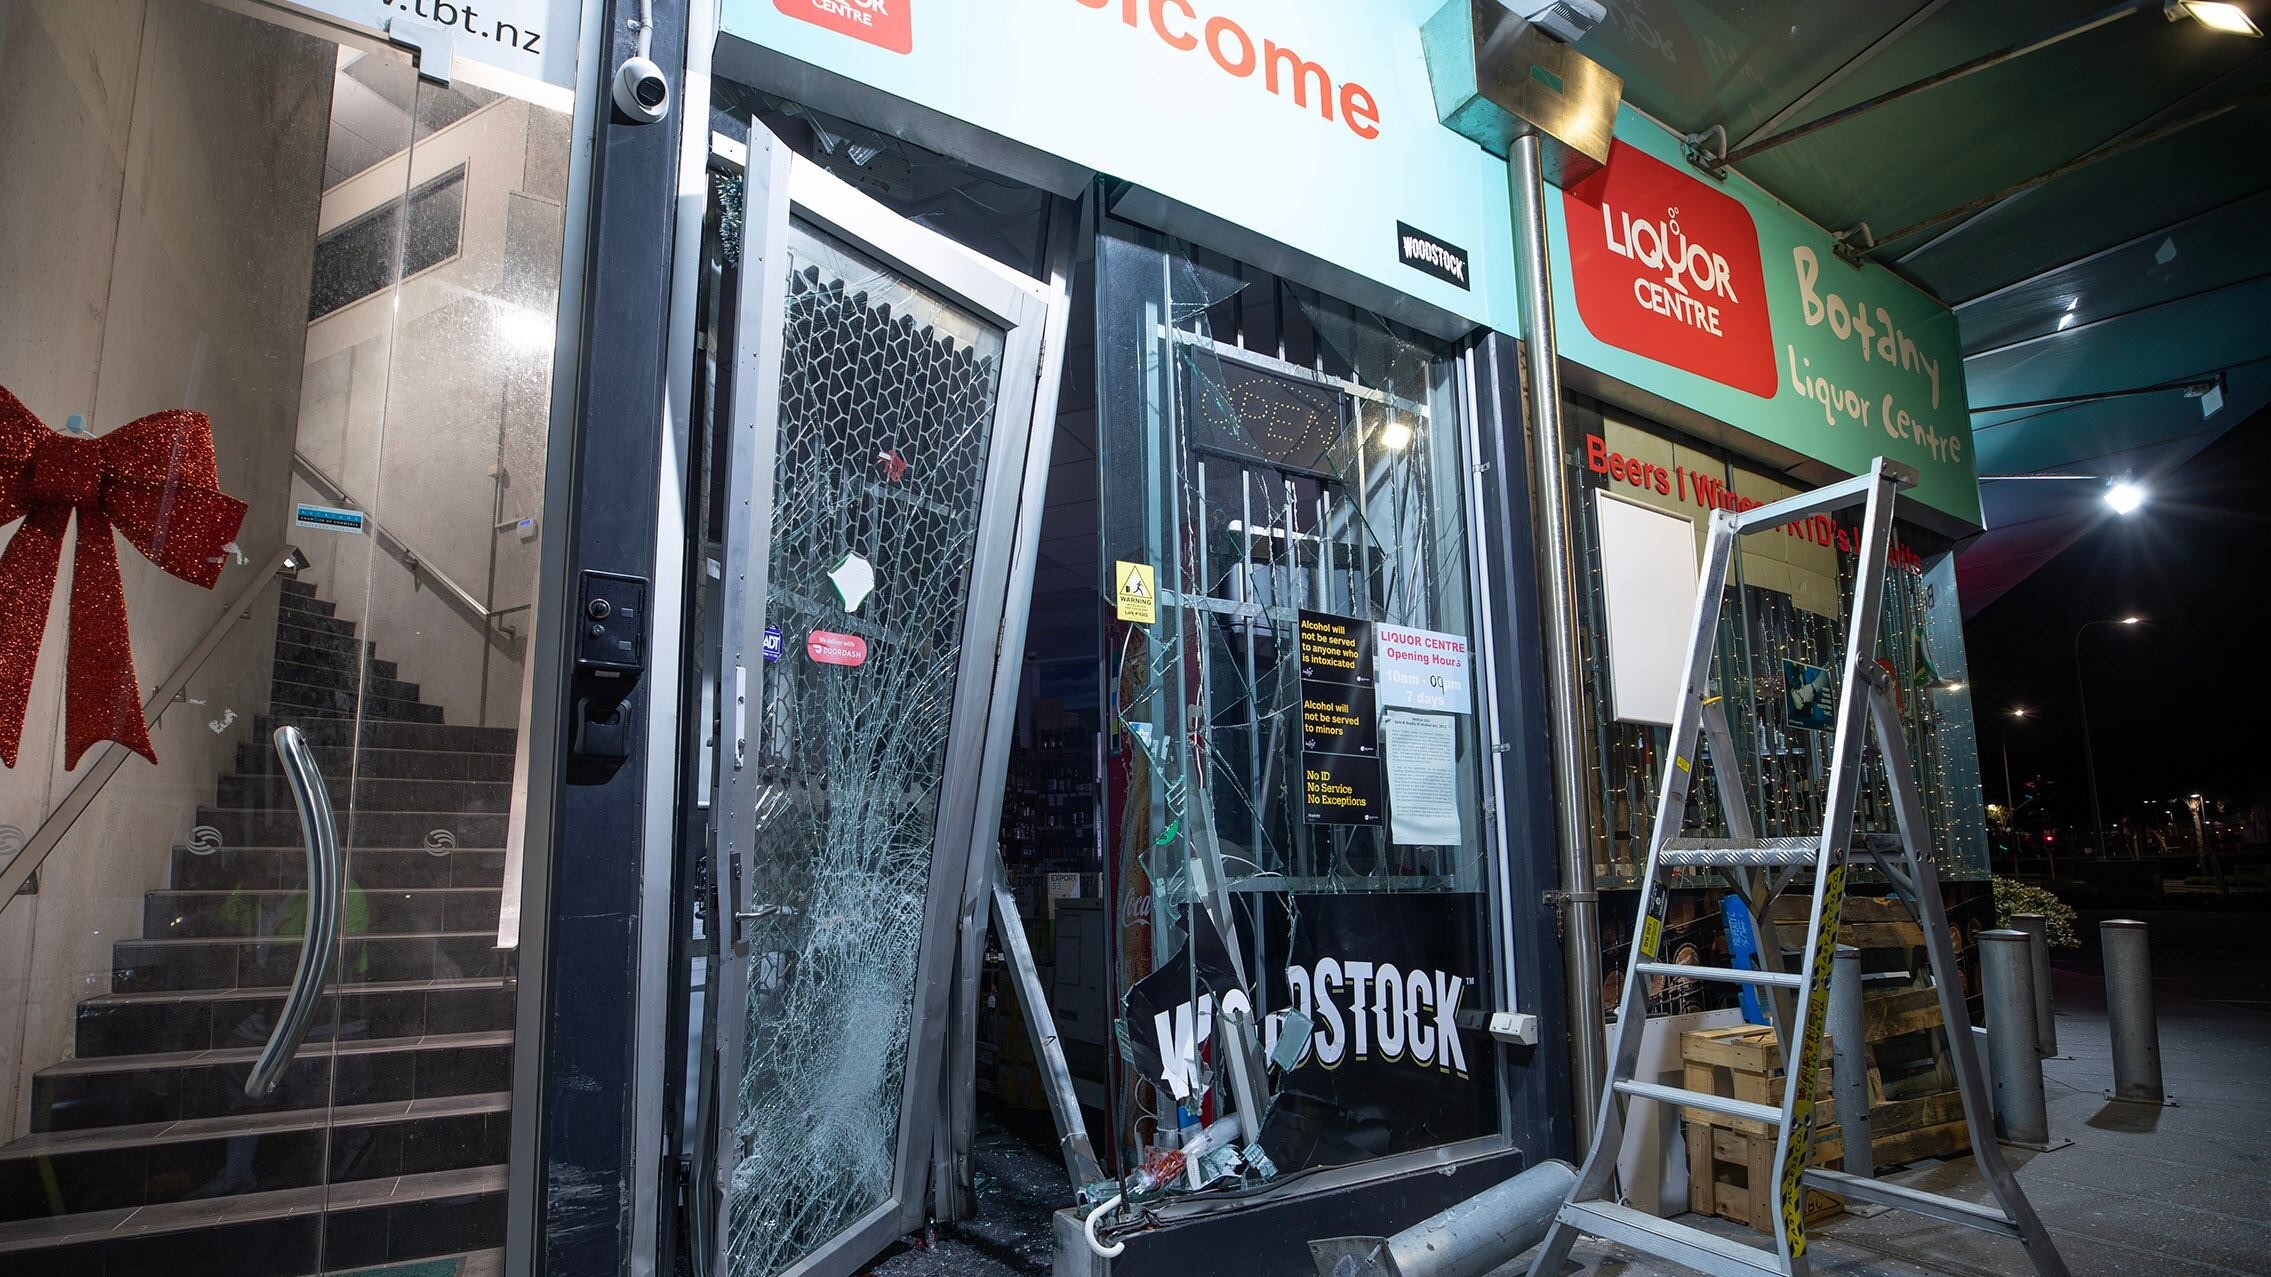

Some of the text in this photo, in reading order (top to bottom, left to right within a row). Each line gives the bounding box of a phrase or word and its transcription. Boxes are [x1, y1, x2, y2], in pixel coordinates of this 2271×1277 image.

[383, 0, 541, 55] .tbt.nz
[1074, 0, 1380, 140] come
[1402, 236, 1465, 283] WOODSTOCK
[1601, 201, 1739, 304] LIQUOR
[1633, 277, 1724, 338] CENTRE
[1792, 245, 1941, 410] Botany
[1787, 344, 1962, 464] Liquor Centre
[1586, 433, 1671, 496] Beers
[1120, 596, 1152, 606] WARNING
[1301, 620, 1346, 635] Alcohol will
[762, 635, 781, 651] ADT
[1301, 632, 1356, 647] not be served
[1380, 630, 1465, 653] LIQUOR CENTRE
[823, 647, 862, 659] DOORDASH
[1302, 643, 1359, 659] to anyone who
[1387, 647, 1461, 668] Opening Hours
[1302, 653, 1356, 669] is intoxicated
[1386, 669, 1419, 686] 10am
[1303, 700, 1349, 713] Alcohol will
[1406, 690, 1446, 708] 7 days
[1304, 712, 1360, 726] not be served
[1304, 723, 1344, 736] to minors
[1306, 770, 1331, 782] No ID
[1307, 782, 1353, 795] No Service
[1307, 793, 1367, 808] No Exceptions
[1050, 874, 1077, 882] EXPORT
